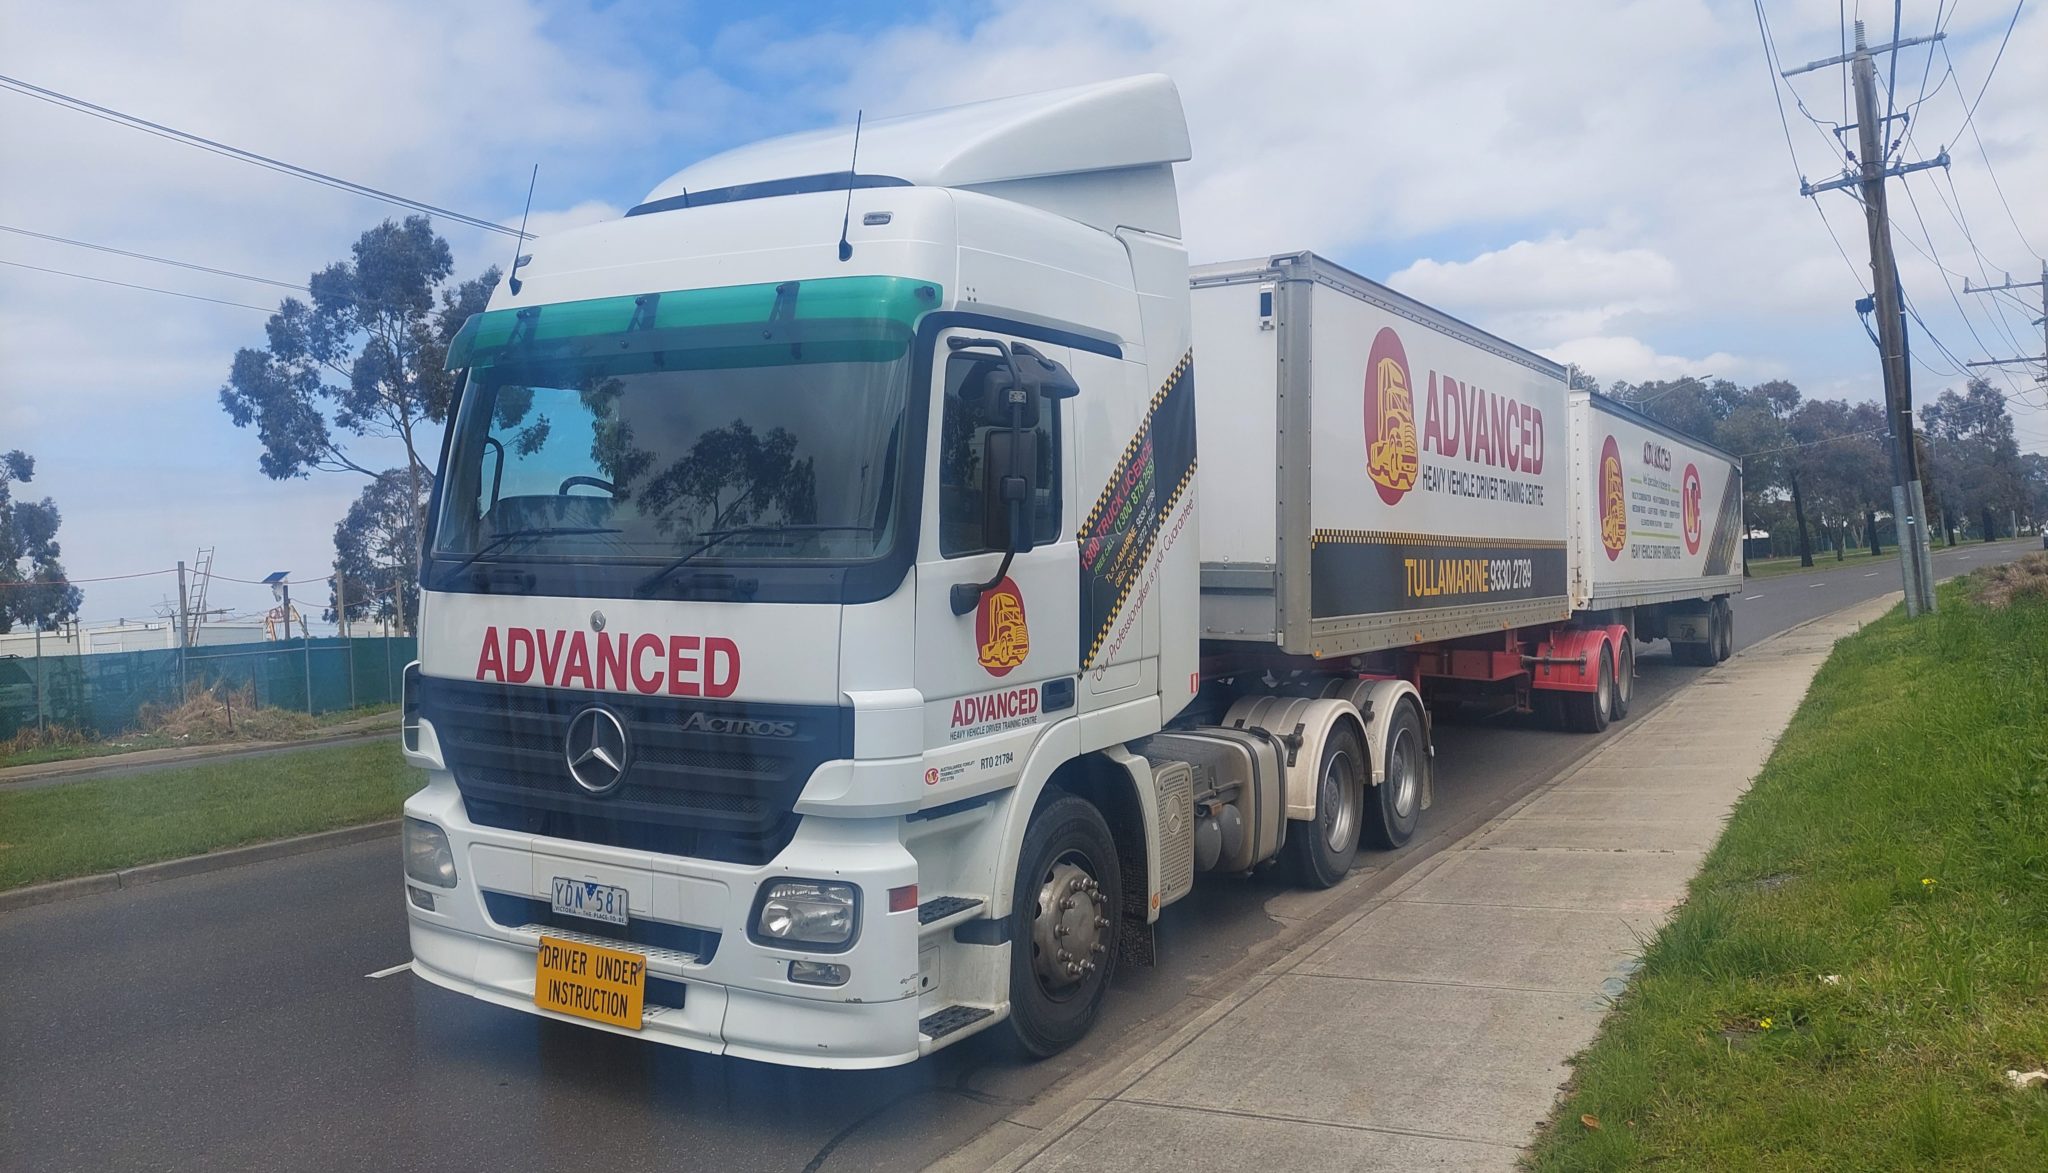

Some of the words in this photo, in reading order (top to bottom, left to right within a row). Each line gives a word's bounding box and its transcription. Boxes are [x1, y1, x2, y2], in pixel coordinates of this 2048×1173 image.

[1423, 369, 1544, 476] ADVANCED
[1082, 537, 1100, 571] 1300
[1096, 490, 1124, 540] TRUCK
[1121, 438, 1153, 497] LICENCE
[1422, 463, 1446, 494] HEAVY
[1447, 469, 1476, 499] VEHICLE
[1476, 474, 1499, 501] DRIVER
[1499, 478, 1524, 504] TRAINING
[1525, 484, 1544, 507] CENTRE
[1104, 538, 1115, 557] CALL
[1114, 500, 1132, 536] (1300
[1130, 480, 1145, 505] 878
[1405, 559, 1488, 597] TULLAMARINE
[1490, 560, 1511, 591] 9330
[1513, 558, 1532, 589] 2789
[475, 626, 741, 698] ADVANCED
[949, 729, 966, 741] HEAVY
[966, 725, 985, 738] VEHICLE
[985, 722, 1002, 734] DRIVER
[1002, 719, 1022, 730] TRAINING
[1021, 715, 1038, 727] CENTRE
[951, 687, 1039, 729] ADVANCED
[980, 756, 994, 771] RTO
[994, 751, 1014, 767] 21784
[555, 882, 584, 910] YDN
[596, 889, 623, 917] 581
[555, 905, 576, 914] VICTORIA
[582, 910, 592, 918] THE
[593, 913, 608, 921] PLACE
[543, 945, 588, 977] DRIVER
[595, 954, 638, 987] UNDER
[548, 978, 628, 1020] INSTRUCTION
